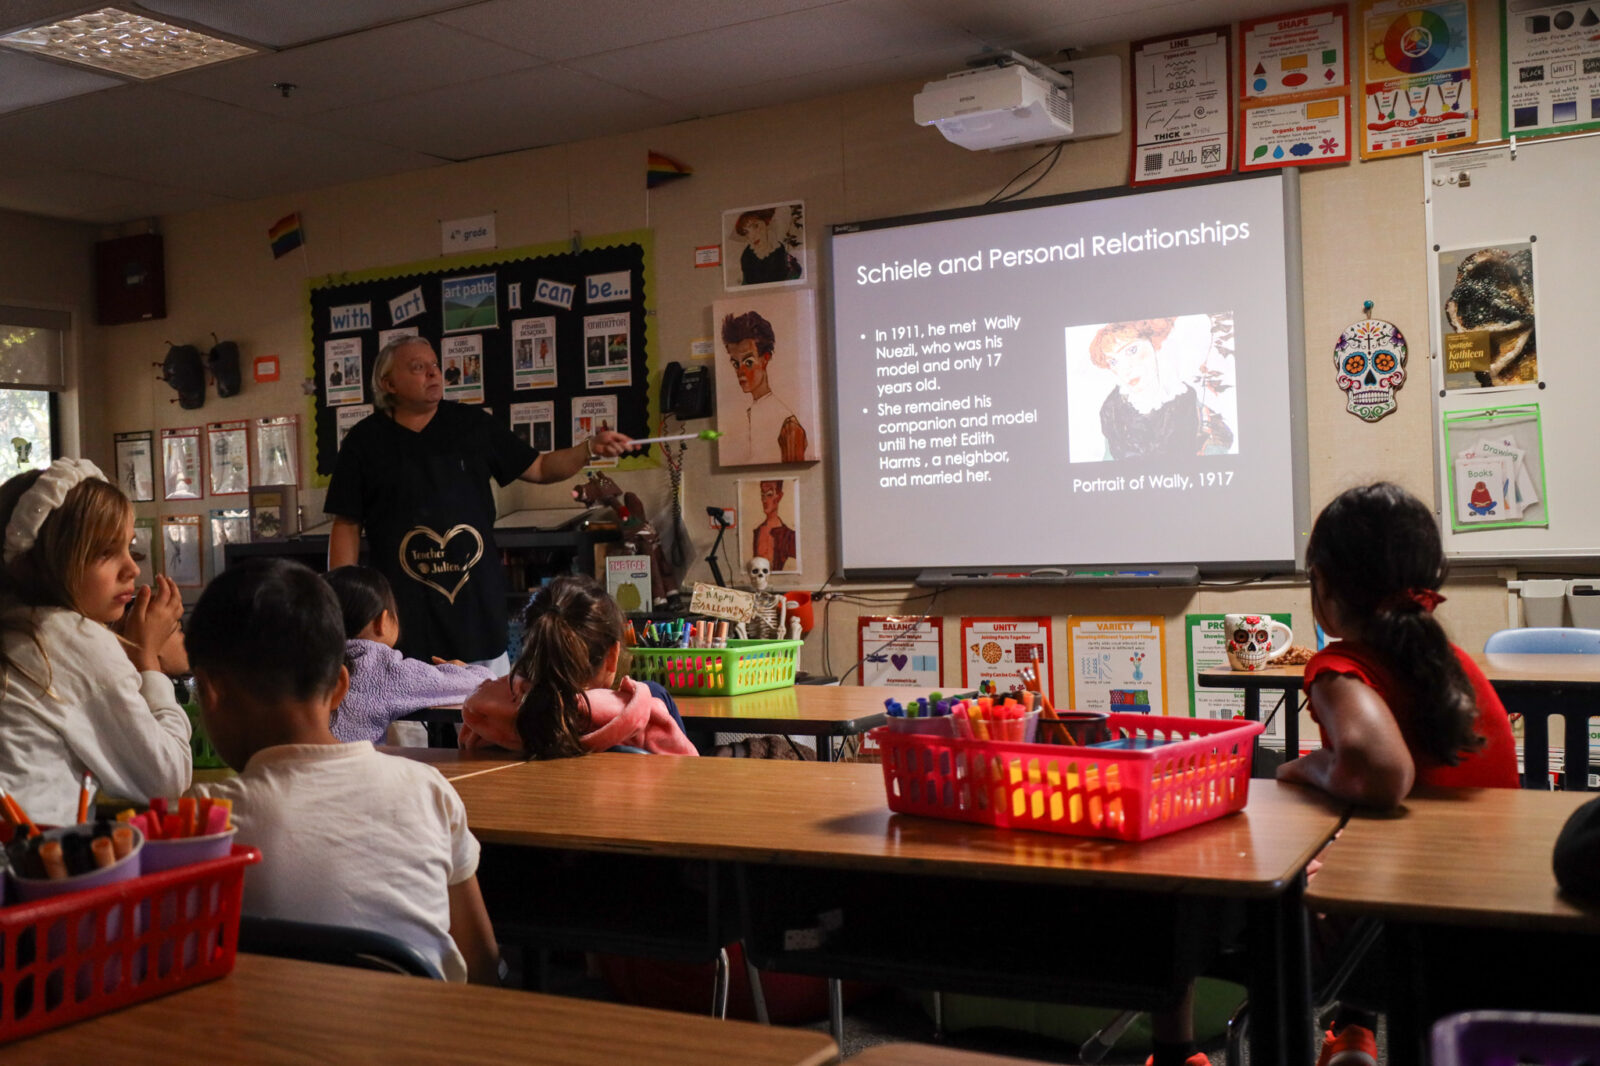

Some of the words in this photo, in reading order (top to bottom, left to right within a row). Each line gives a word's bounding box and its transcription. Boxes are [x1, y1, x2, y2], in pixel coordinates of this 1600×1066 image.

[1278, 18, 1309, 30] SHAPE
[1169, 39, 1189, 49] LINE
[1521, 69, 1542, 78] BLACK
[1553, 64, 1573, 73] WHITE
[1394, 119, 1419, 127] COLOR
[1154, 131, 1180, 141] THICK
[464, 227, 489, 241] grade
[857, 259, 932, 285] Schiele
[938, 250, 982, 275] and
[989, 237, 1085, 269] Personal
[1092, 220, 1250, 256] Relationships
[332, 307, 370, 329] with
[394, 293, 421, 321] art
[444, 286, 461, 298] art
[463, 280, 496, 297] paths
[511, 285, 517, 306] i
[538, 283, 572, 304] can
[588, 278, 629, 299] be...
[587, 318, 626, 330] ANIMATOR
[875, 329, 887, 342] In
[891, 325, 925, 340] 1911,
[928, 323, 946, 336] he
[949, 319, 976, 334] met
[984, 315, 1021, 331] Wally
[876, 343, 918, 359] Nuezil,
[921, 341, 950, 355] who
[954, 338, 982, 351] was
[985, 335, 1003, 349] his
[1449, 349, 1484, 360] Kathleen
[877, 361, 919, 377] model
[923, 358, 950, 373] and
[953, 356, 982, 371] only
[987, 353, 1002, 367] 17
[1449, 360, 1471, 371] Ryan
[877, 382, 912, 397] years
[915, 377, 941, 392] old.
[877, 403, 902, 416] She
[905, 396, 971, 414] remained
[974, 395, 992, 409] his
[878, 416, 956, 434] companion
[960, 413, 988, 428] and
[992, 409, 1037, 425] model
[879, 437, 906, 452] until
[909, 436, 926, 450] he
[930, 434, 957, 448] met
[961, 432, 994, 446] Edith
[932, 456, 942, 467] a
[945, 450, 1010, 468] neighbor,
[1483, 443, 1518, 462] Drawing
[880, 474, 907, 488] and
[910, 470, 962, 486] married
[966, 469, 992, 483] her.
[1467, 469, 1493, 478] Books
[1073, 476, 1125, 493] Portrait
[1129, 475, 1145, 490] of
[1148, 473, 1194, 491] Wally,
[1199, 471, 1234, 487] 1917
[411, 547, 445, 560] Teacher
[431, 561, 460, 574] Julien
[882, 623, 918, 631] BALANCE
[993, 623, 1018, 631] UNITY
[1096, 622, 1135, 631] VARIETY
